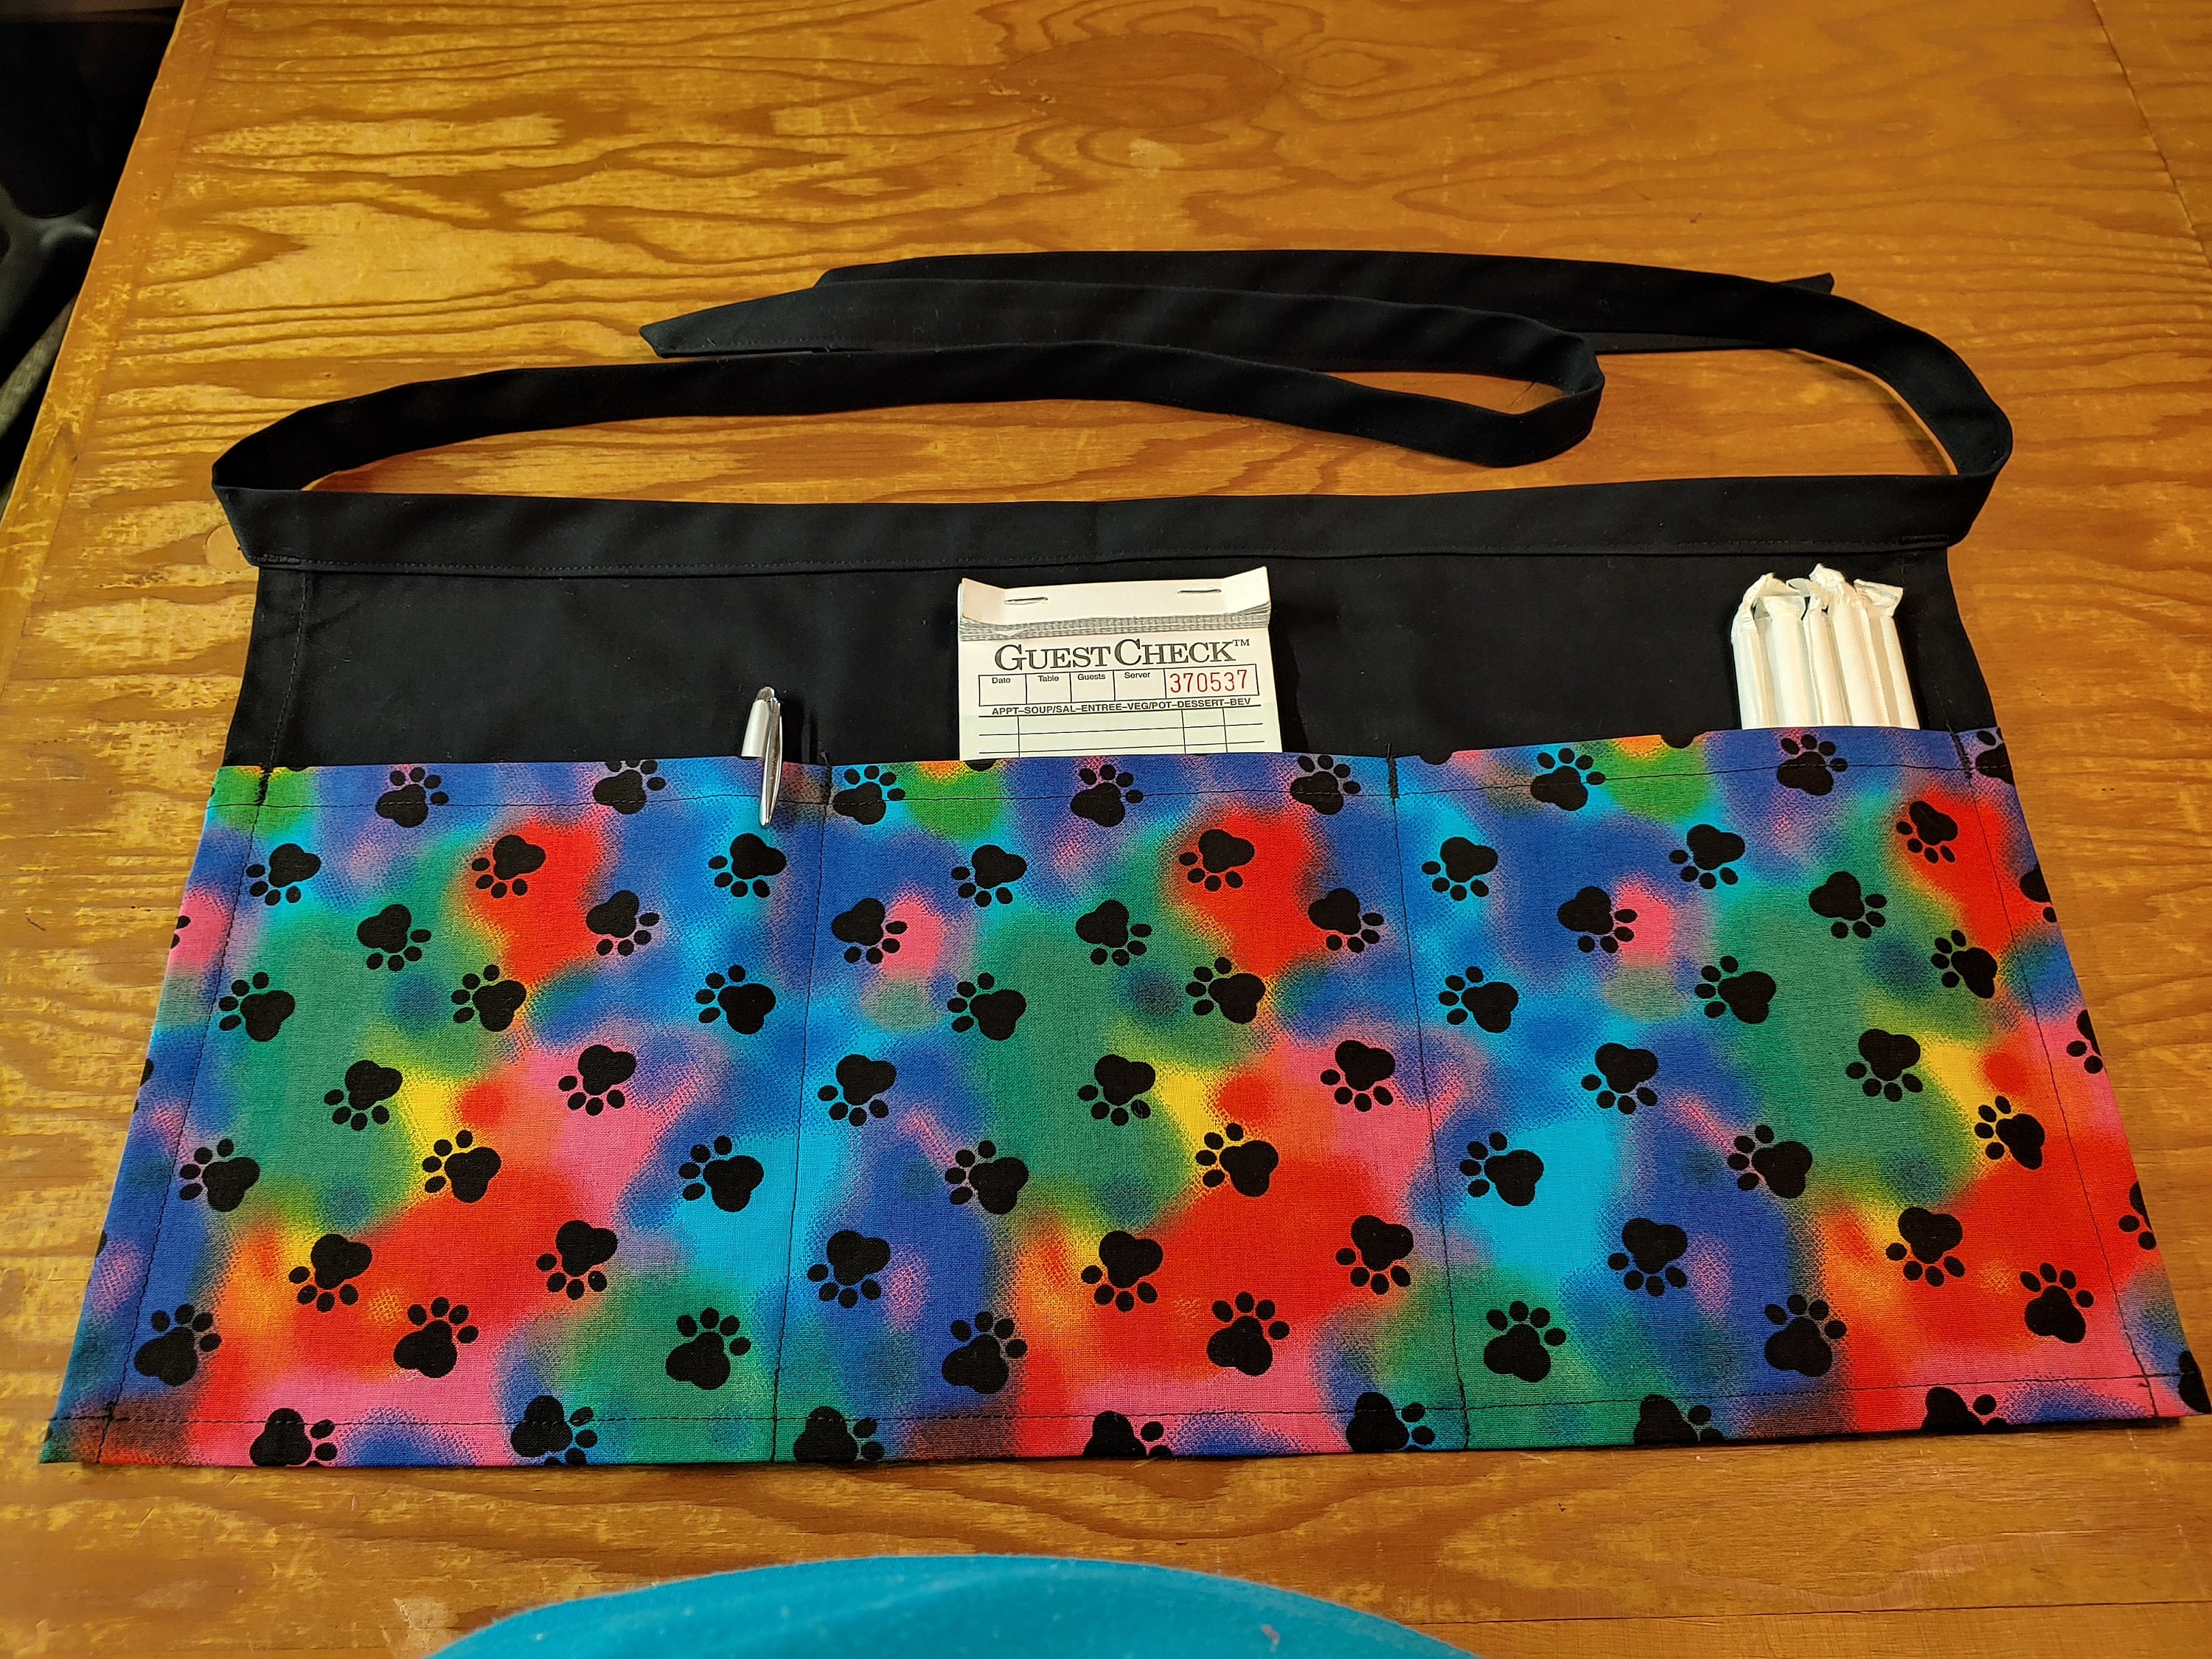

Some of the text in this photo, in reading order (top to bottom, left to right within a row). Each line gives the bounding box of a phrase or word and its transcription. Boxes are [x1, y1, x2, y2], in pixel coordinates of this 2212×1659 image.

[995, 644, 1110, 671] GUEST
[1077, 672, 1106, 681] Guests
[1124, 671, 1151, 679] Server
[1169, 669, 1248, 694] 370537
